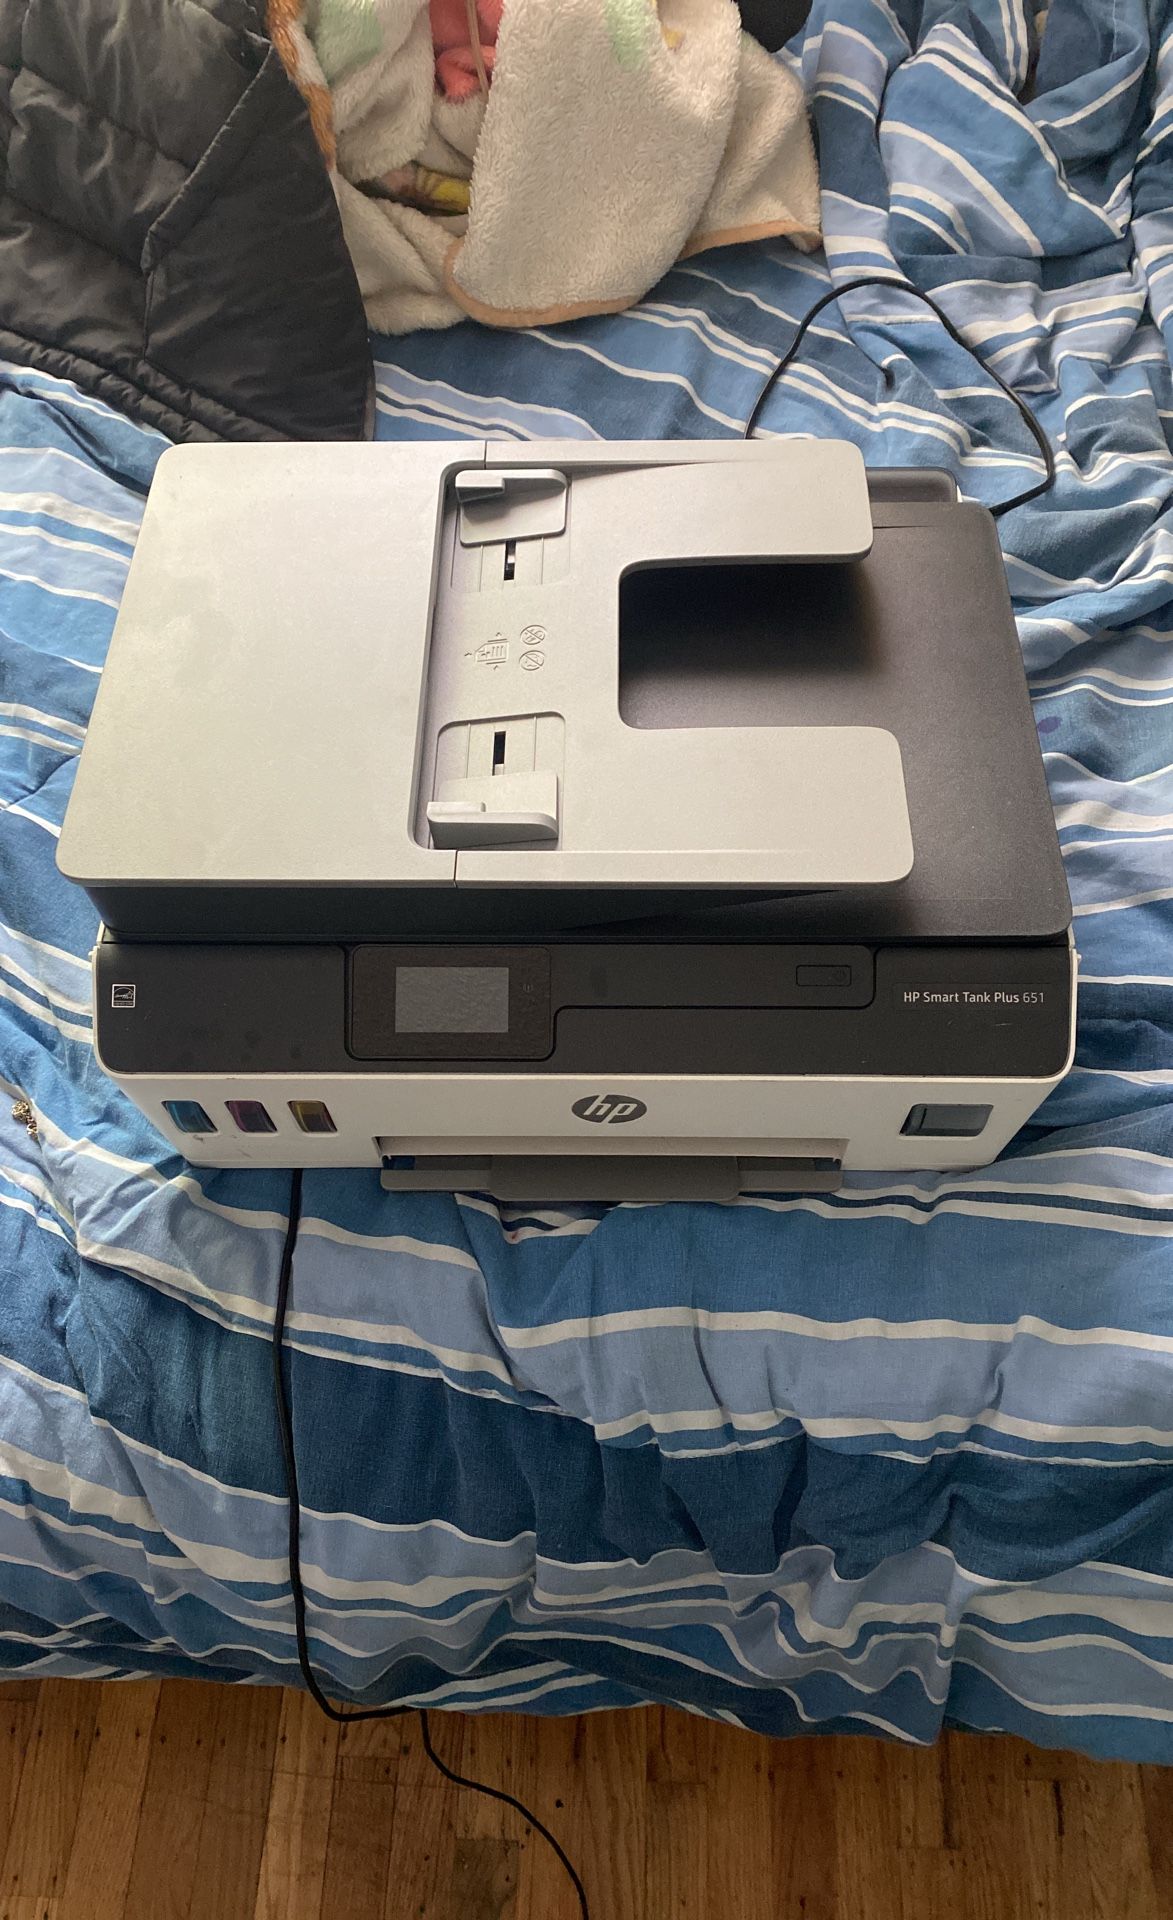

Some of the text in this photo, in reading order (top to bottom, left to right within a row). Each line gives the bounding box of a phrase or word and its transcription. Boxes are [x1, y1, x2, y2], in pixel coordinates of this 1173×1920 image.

[903, 991, 1044, 1004] HP Smart Tank Plus 651
[581, 1094, 639, 1123] hp
